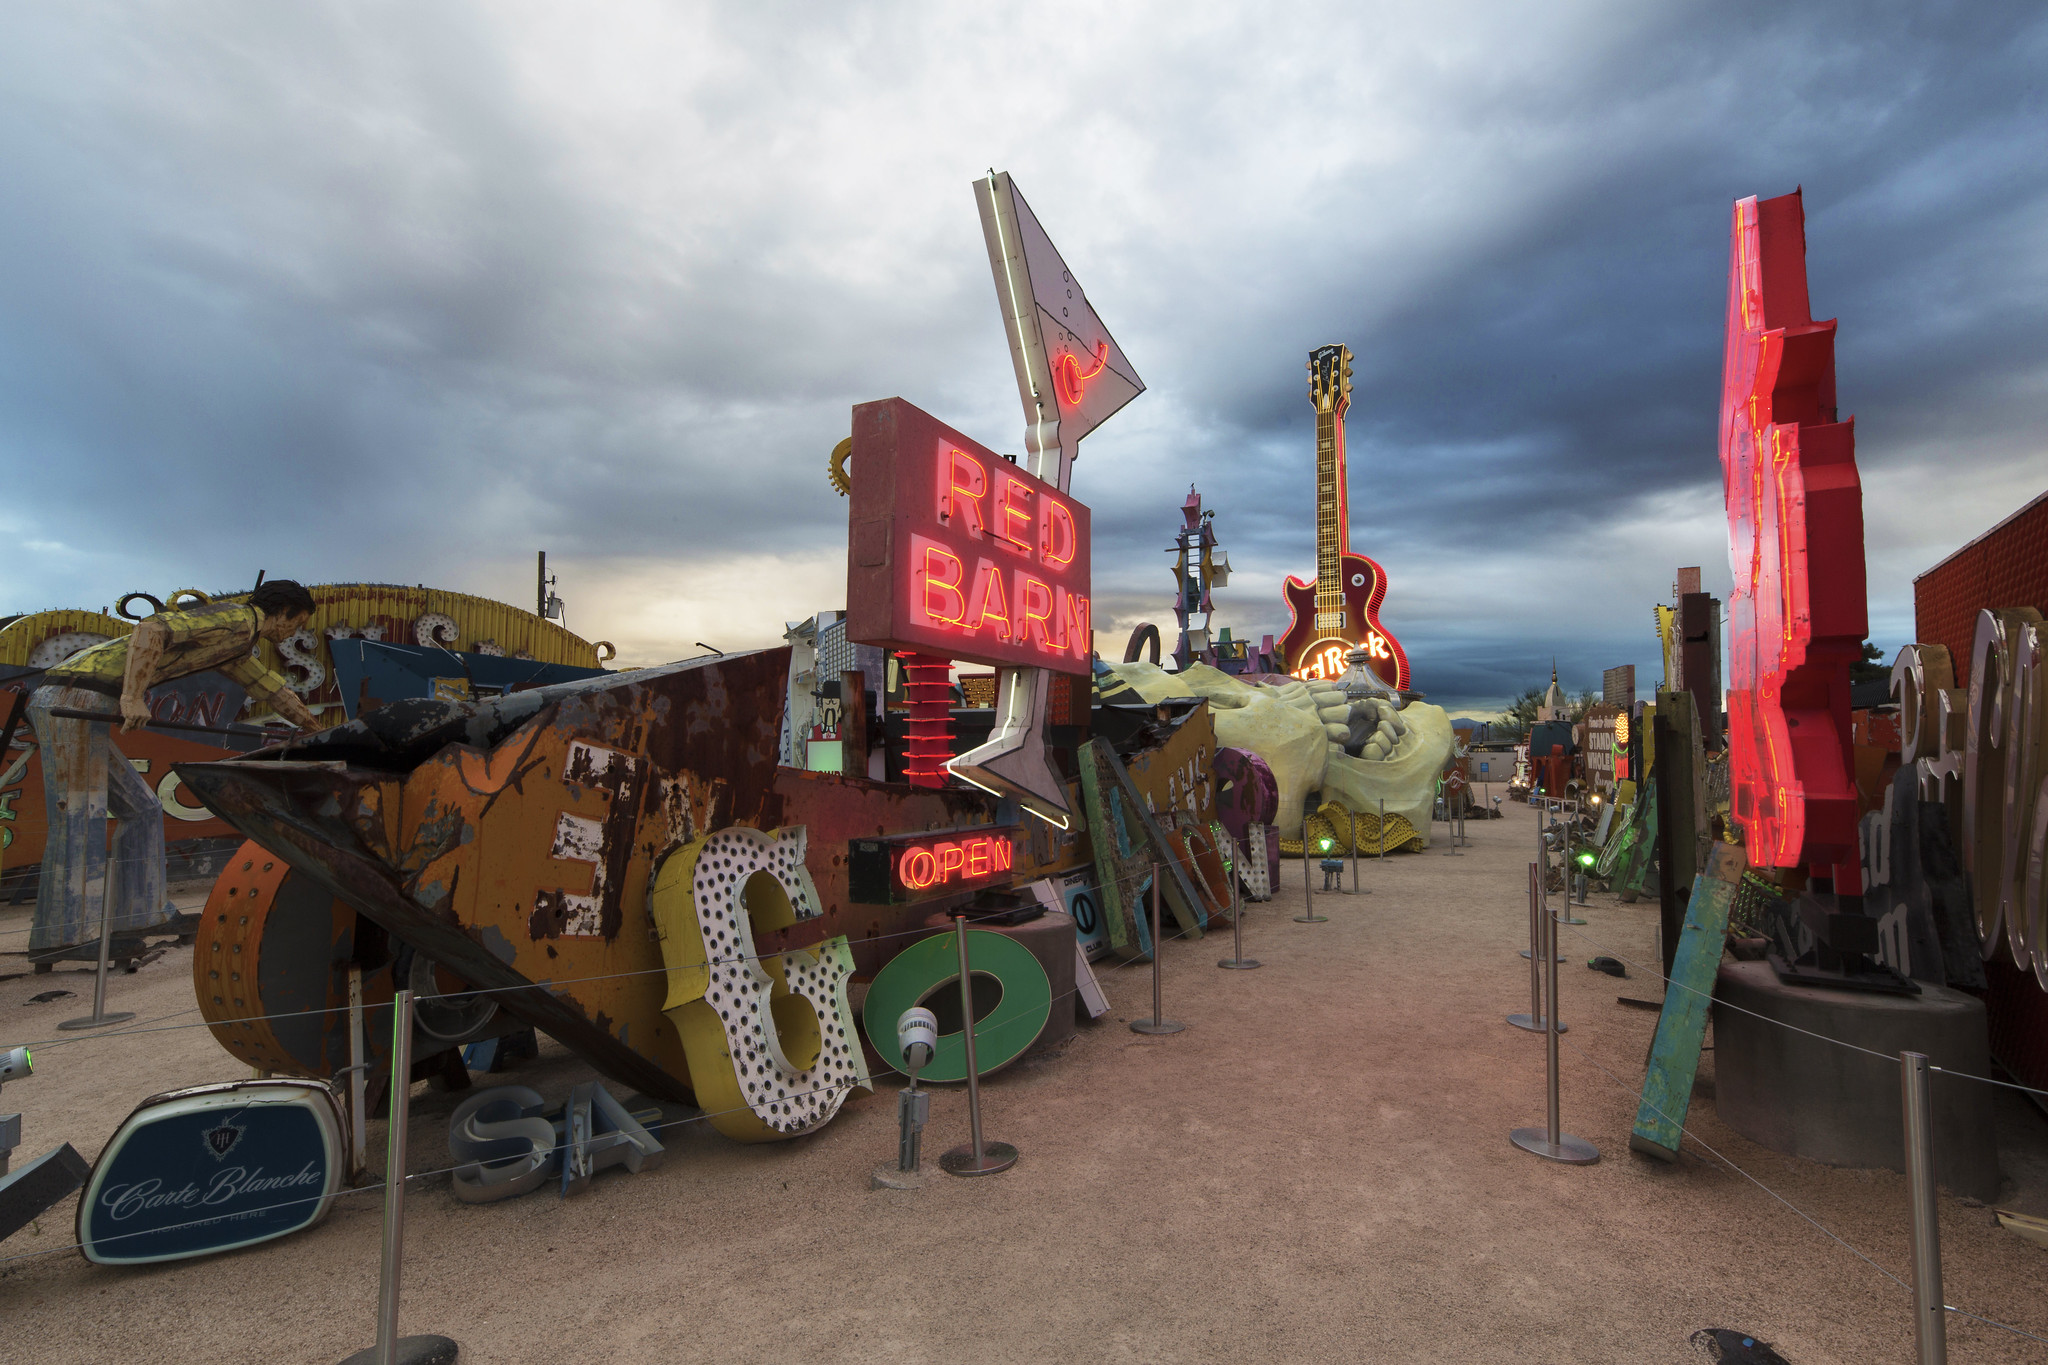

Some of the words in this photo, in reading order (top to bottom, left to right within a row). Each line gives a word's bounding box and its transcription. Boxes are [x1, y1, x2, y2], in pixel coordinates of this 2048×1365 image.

[937, 437, 1076, 572] RED
[910, 533, 1089, 661] BARN
[899, 834, 1011, 889] OPEN
[101, 1177, 200, 1221] Carte
[186, 1160, 321, 1208] Blanche
[229, 1209, 267, 1221] HERE
